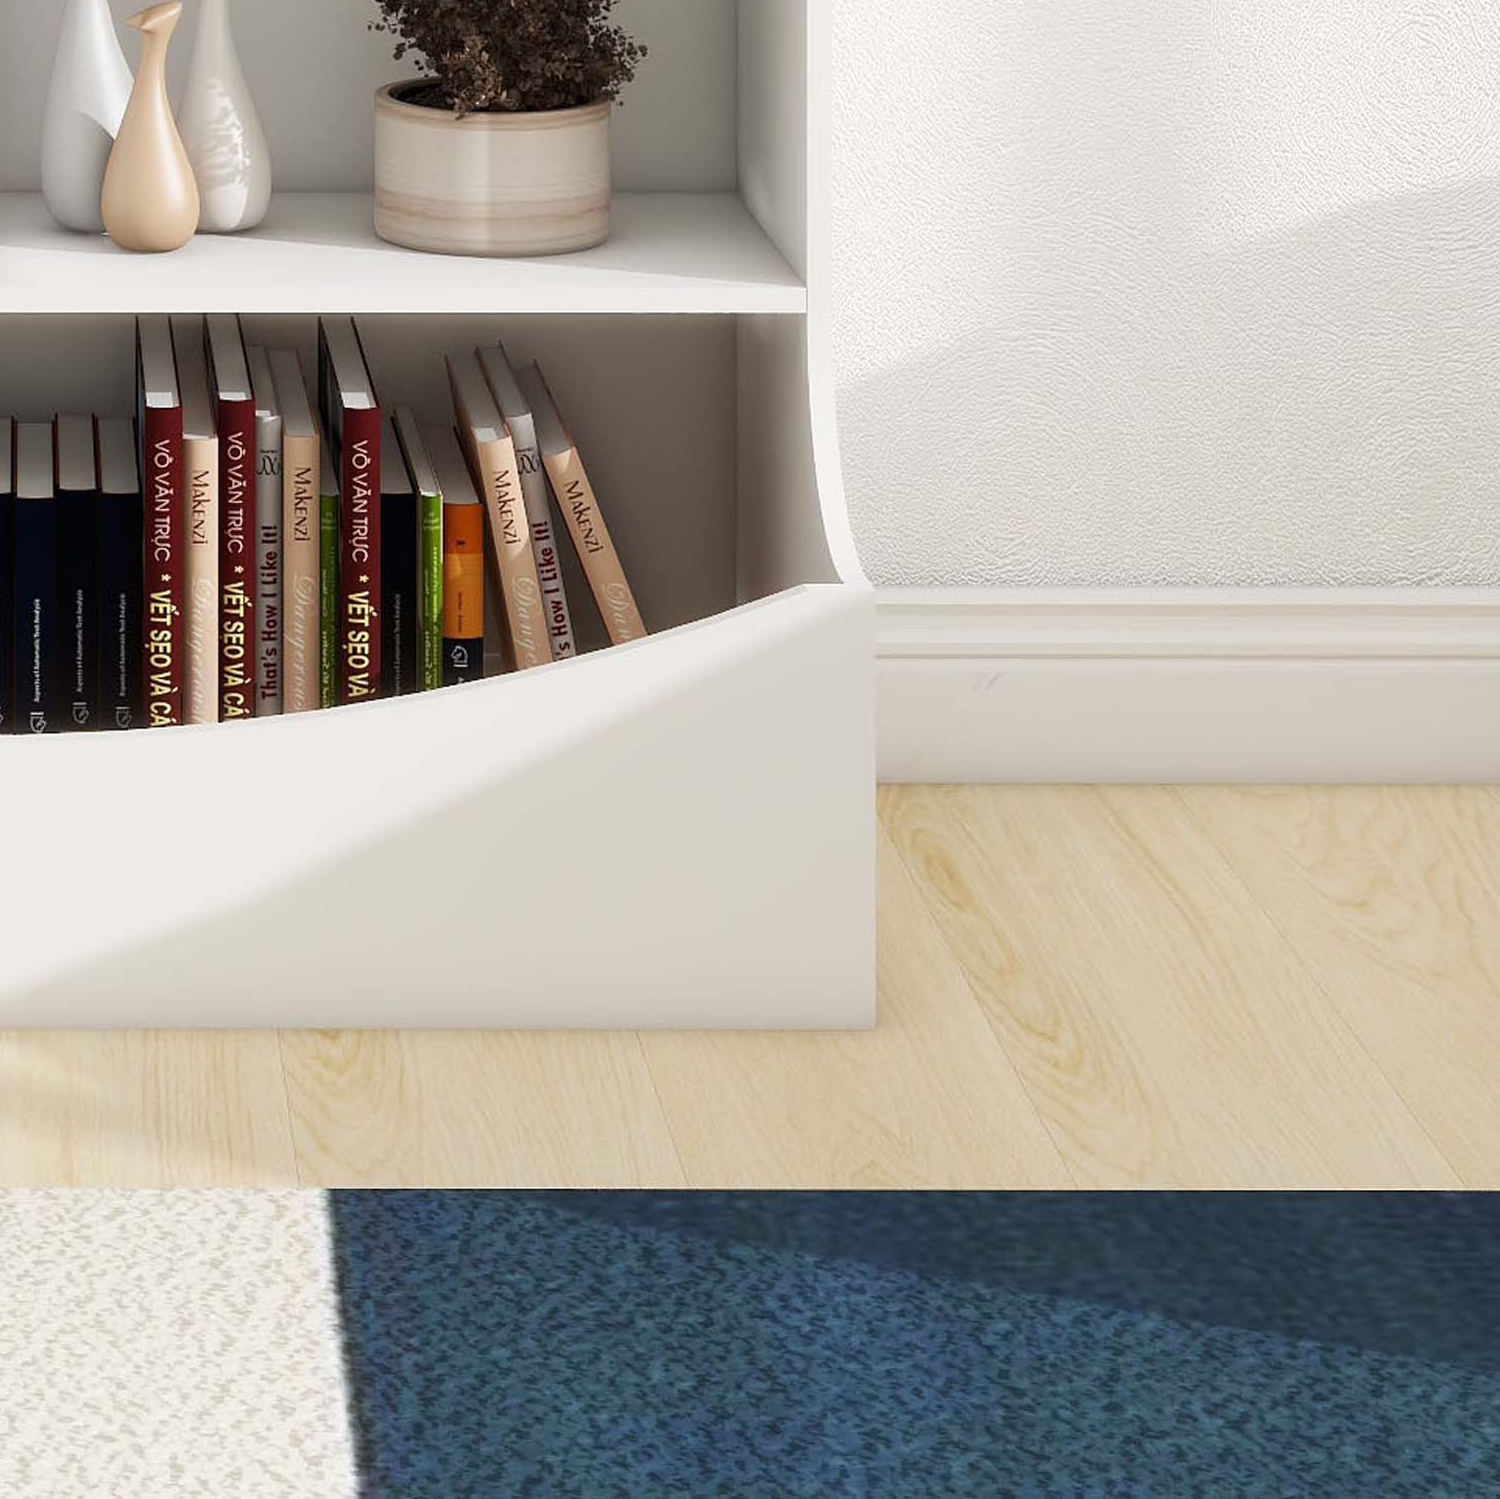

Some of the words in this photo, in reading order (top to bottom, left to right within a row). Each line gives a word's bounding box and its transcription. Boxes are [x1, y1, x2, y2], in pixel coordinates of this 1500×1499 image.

[154, 471, 174, 512] VĂN
[227, 464, 247, 504] VĂN
[351, 473, 372, 513] VĂN
[260, 525, 277, 544] It!
[531, 520, 550, 542] It!
[259, 551, 278, 585] Like
[537, 546, 557, 582] Like
[149, 589, 180, 626] VẾT
[223, 581, 253, 617] VẾT
[544, 586, 560, 594] I
[261, 604, 278, 642] How
[347, 591, 378, 627] VẾT
[550, 601, 568, 638] How
[144, 629, 172, 668] SẸO
[219, 620, 245, 659] SẸO
[341, 630, 370, 669] SẸO
[149, 671, 179, 696] VÀ
[223, 662, 252, 687] VÀ
[259, 648, 278, 700] That's
[347, 672, 376, 697] VÀ
[149, 701, 177, 727] CÁ
